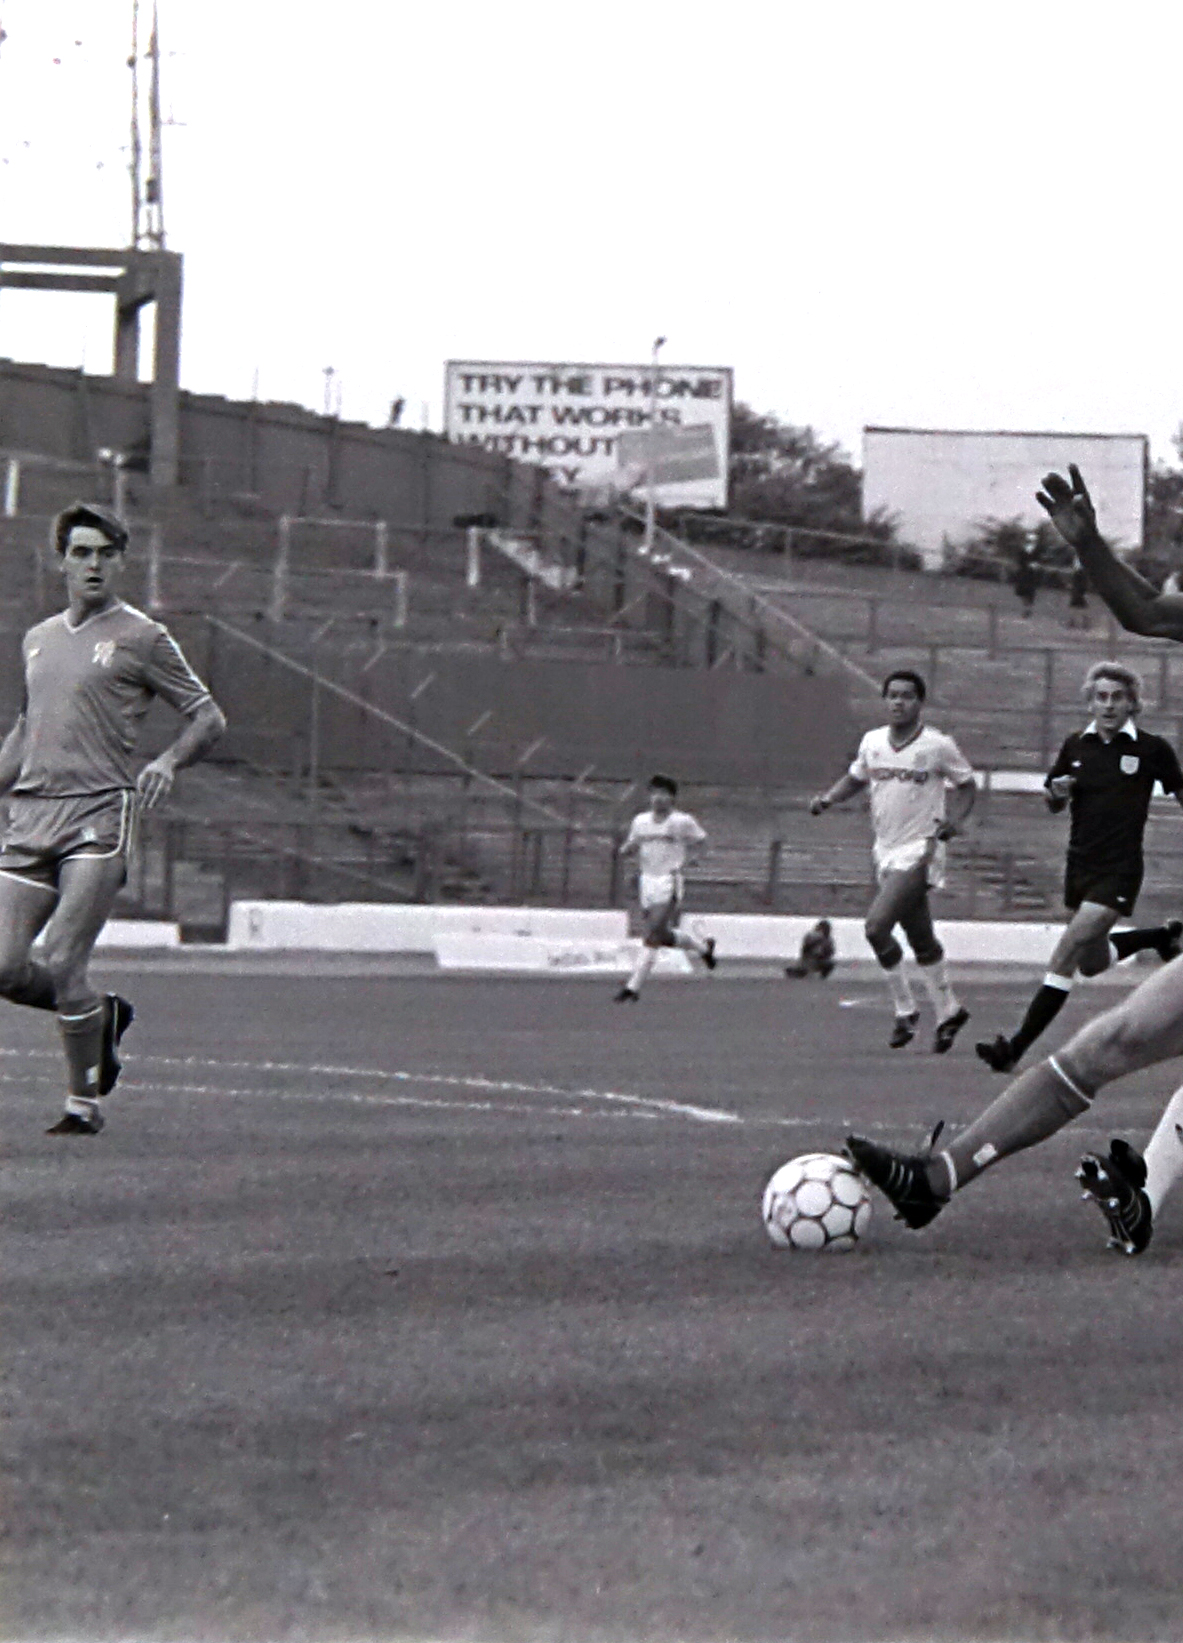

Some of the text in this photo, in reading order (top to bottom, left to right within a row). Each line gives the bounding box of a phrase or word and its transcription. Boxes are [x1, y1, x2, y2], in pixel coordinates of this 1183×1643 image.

[460, 374, 724, 399] TRY THE PHONE
[458, 403, 682, 426] THAT WORKS
